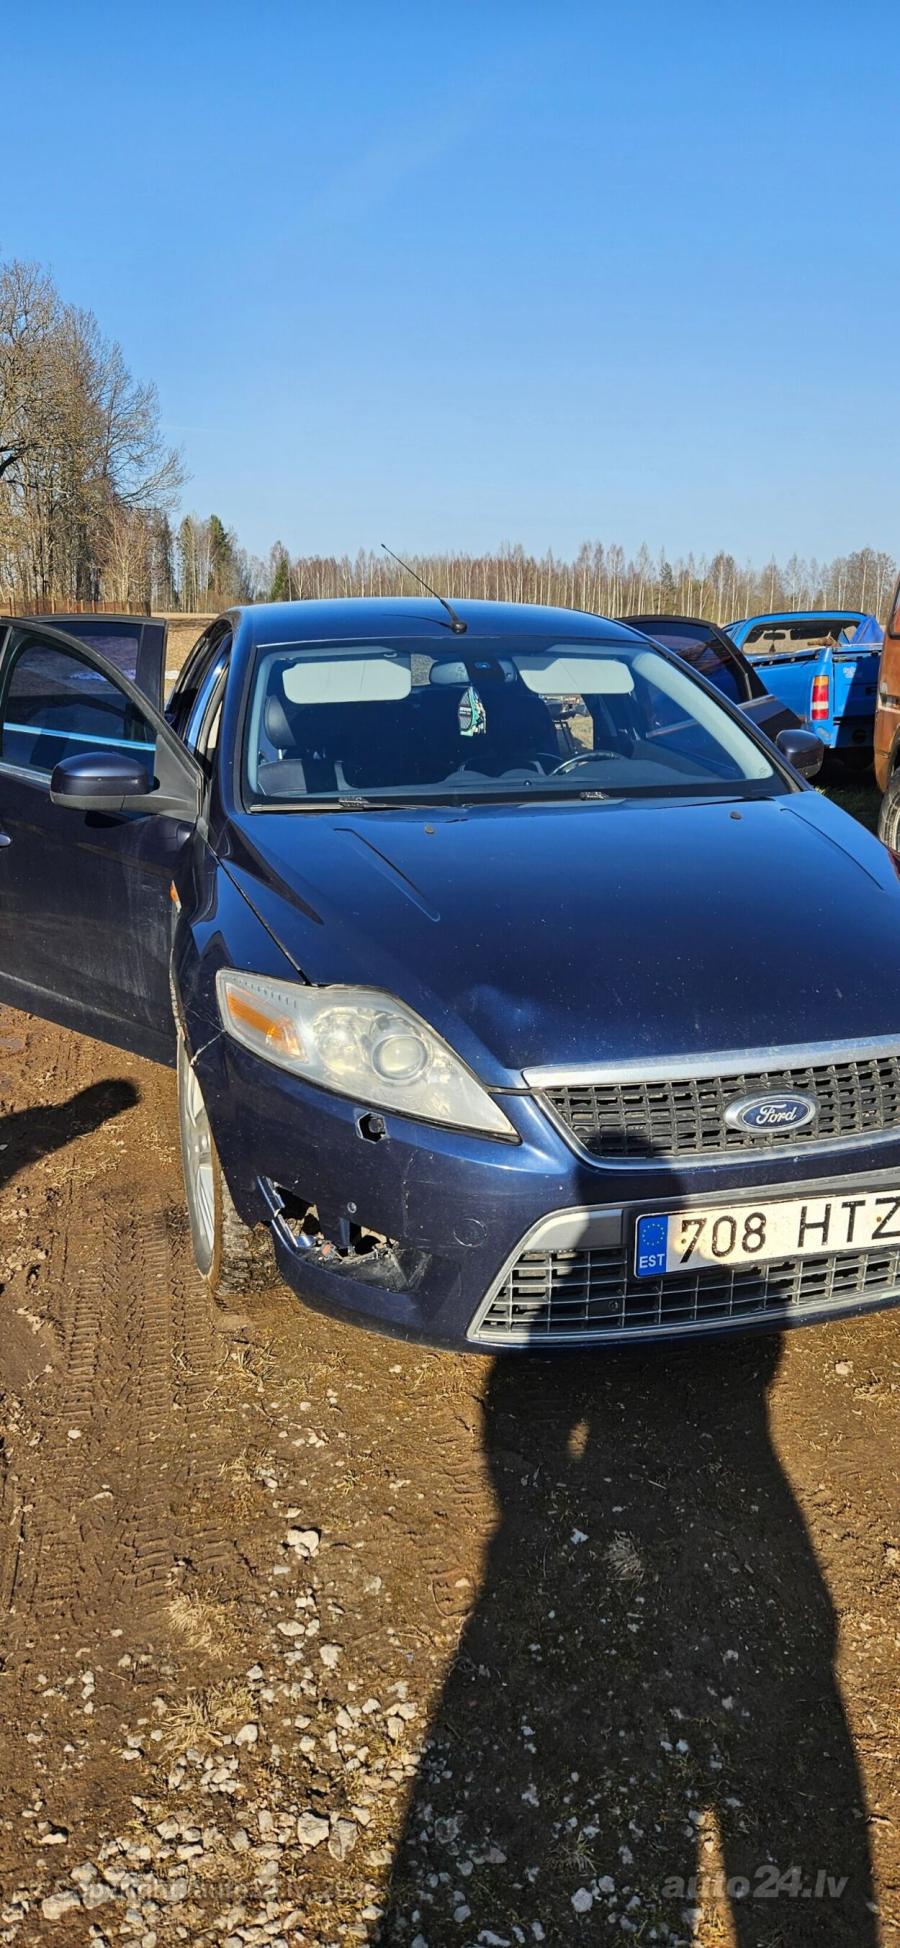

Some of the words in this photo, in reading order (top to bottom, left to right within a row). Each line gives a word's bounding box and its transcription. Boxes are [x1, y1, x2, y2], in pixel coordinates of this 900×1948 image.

[756, 1104, 797, 1124] Ford
[680, 1212, 766, 1263] 708
[798, 1196, 900, 1248] HTZ
[639, 1253, 665, 1269] EST
